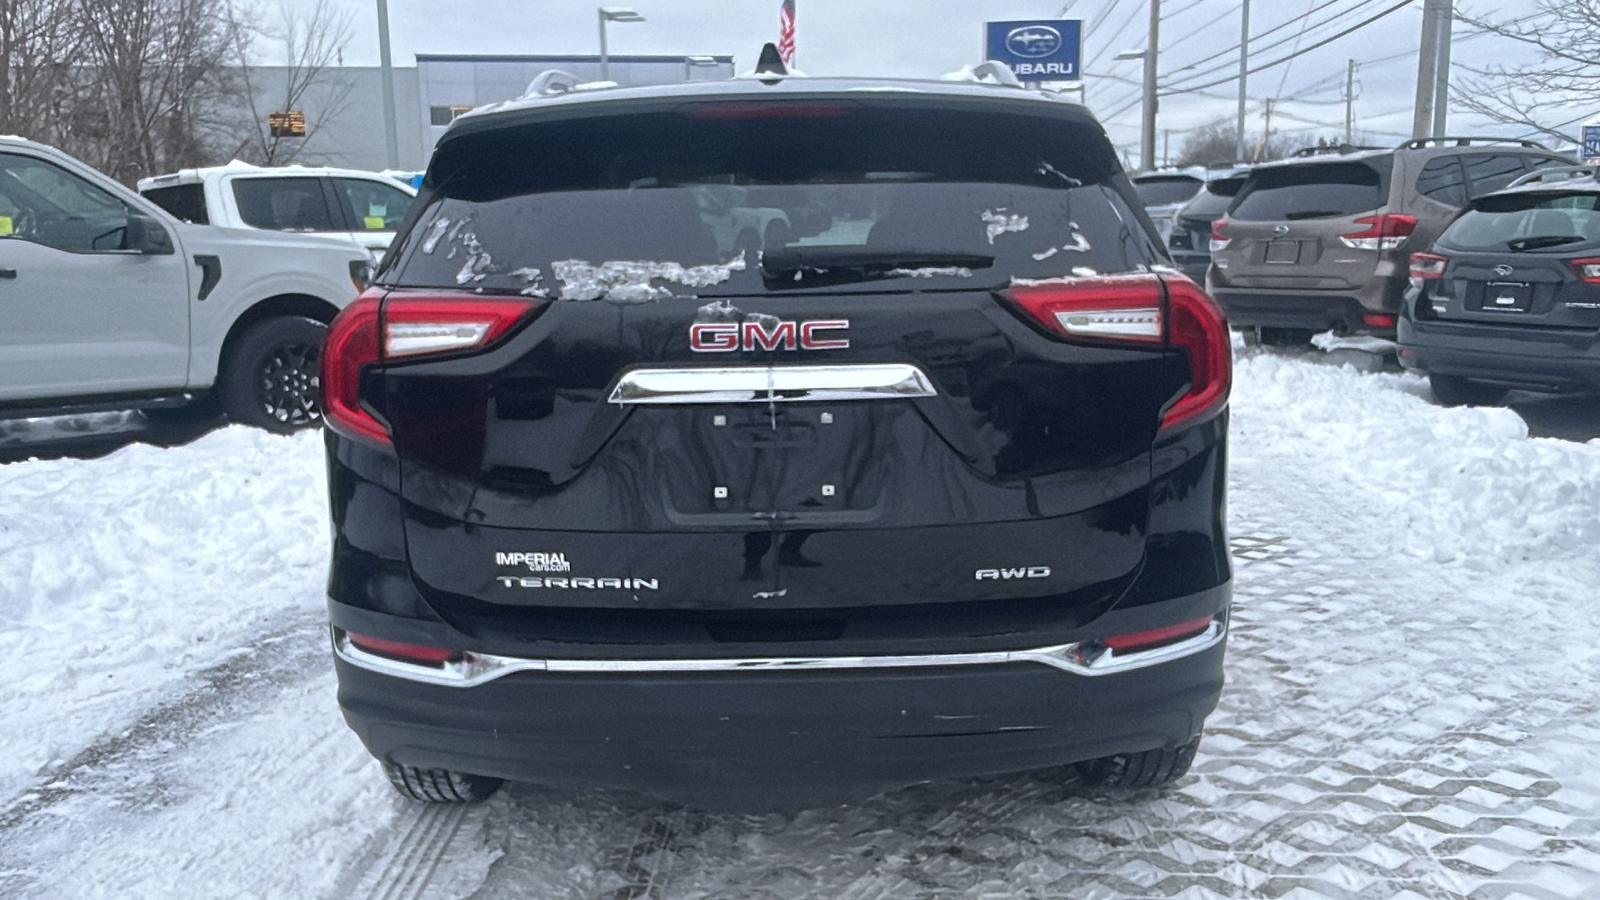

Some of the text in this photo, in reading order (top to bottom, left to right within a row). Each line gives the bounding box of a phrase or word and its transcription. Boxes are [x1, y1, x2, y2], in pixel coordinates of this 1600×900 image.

[1013, 62, 1073, 75] UBARU
[690, 320, 850, 352] GMC
[495, 551, 569, 566] IMPERIAL
[975, 566, 1052, 580] AWD
[496, 576, 659, 589] TERRAIN
